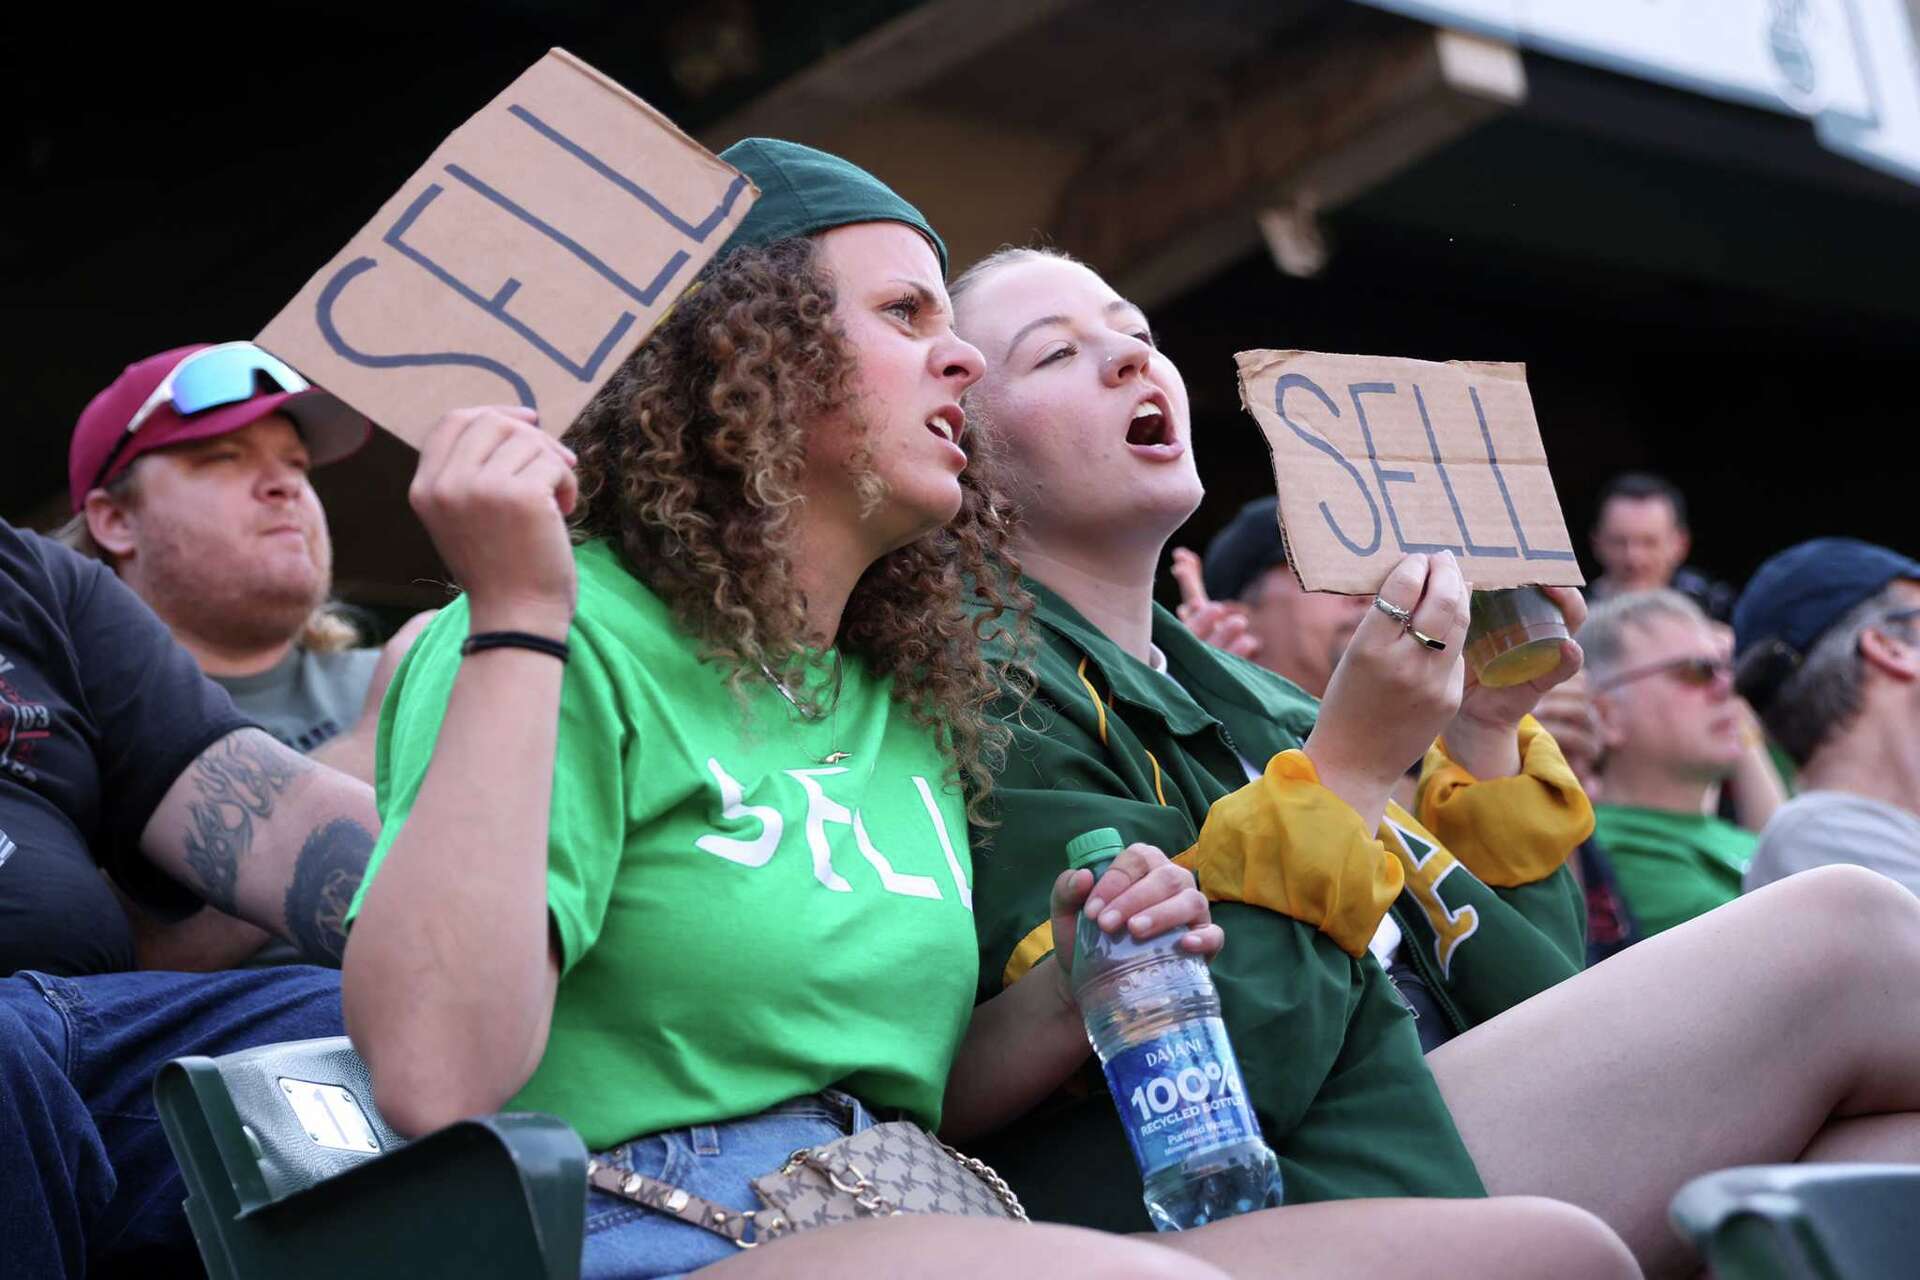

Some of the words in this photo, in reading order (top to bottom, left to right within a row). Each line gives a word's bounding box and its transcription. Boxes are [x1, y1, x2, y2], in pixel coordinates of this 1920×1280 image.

[315, 104, 748, 427] SELL
[1275, 373, 1576, 560] SELL
[1145, 1038, 1203, 1067] DASANI
[1130, 1060, 1242, 1122] 100%
[1140, 1105, 1201, 1137] RECYCLED
